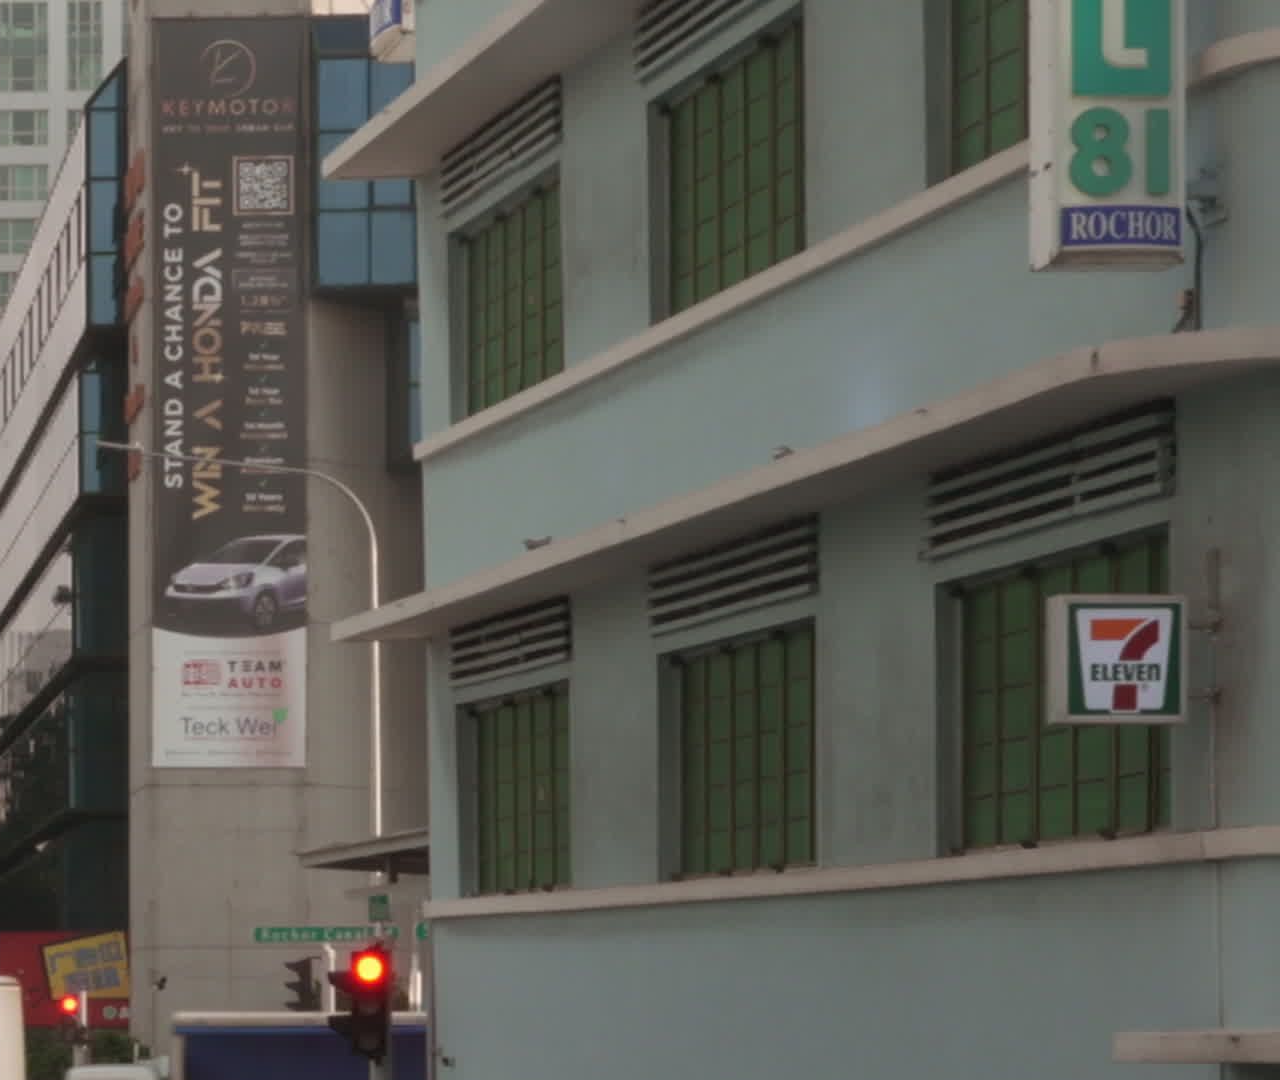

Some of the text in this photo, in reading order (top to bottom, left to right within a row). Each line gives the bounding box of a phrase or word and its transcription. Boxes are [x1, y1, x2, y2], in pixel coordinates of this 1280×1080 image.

[191, 170, 223, 232] FIT
[1070, 210, 1178, 242] ROCHOR
[163, 203, 184, 488] STAND A CHANCE TO
[191, 247, 223, 384] HONDA
[191, 446, 222, 521] WIN
[227, 660, 283, 673] TEAM
[228, 676, 283, 689] AUTO
[1090, 618, 1160, 711] 7
[181, 716, 231, 736] Teck
